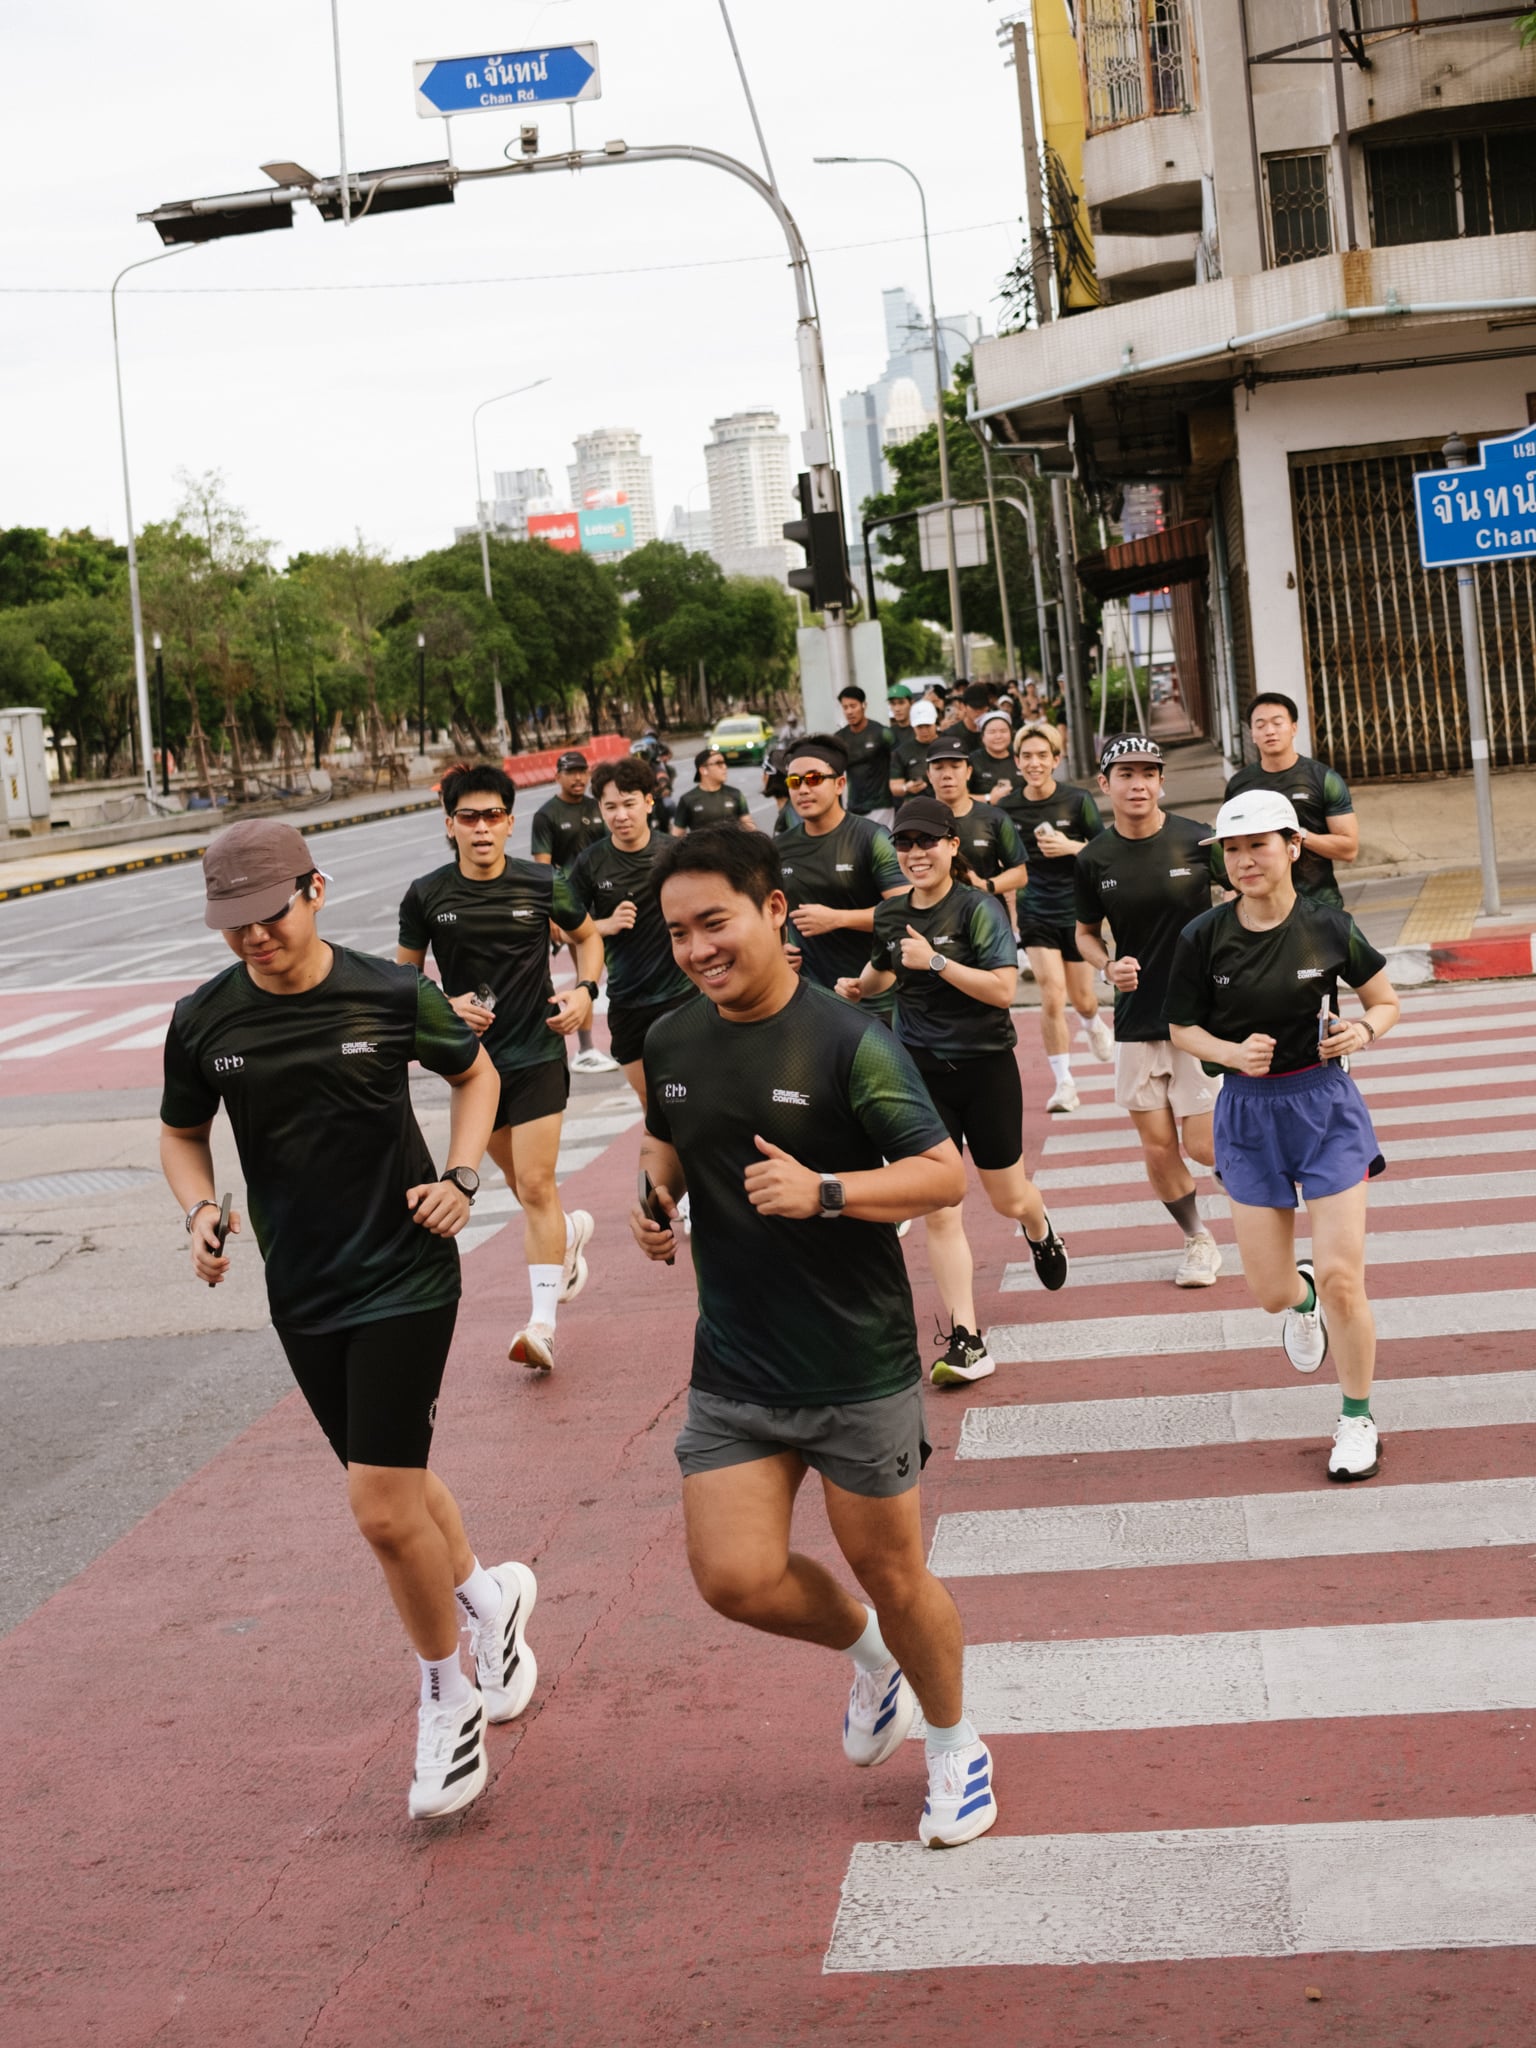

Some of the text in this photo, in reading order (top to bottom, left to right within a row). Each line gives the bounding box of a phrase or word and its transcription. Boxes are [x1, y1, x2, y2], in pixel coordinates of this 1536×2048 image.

[480, 88, 538, 106] Chan Rd.
[1476, 528, 1536, 549] Chan
